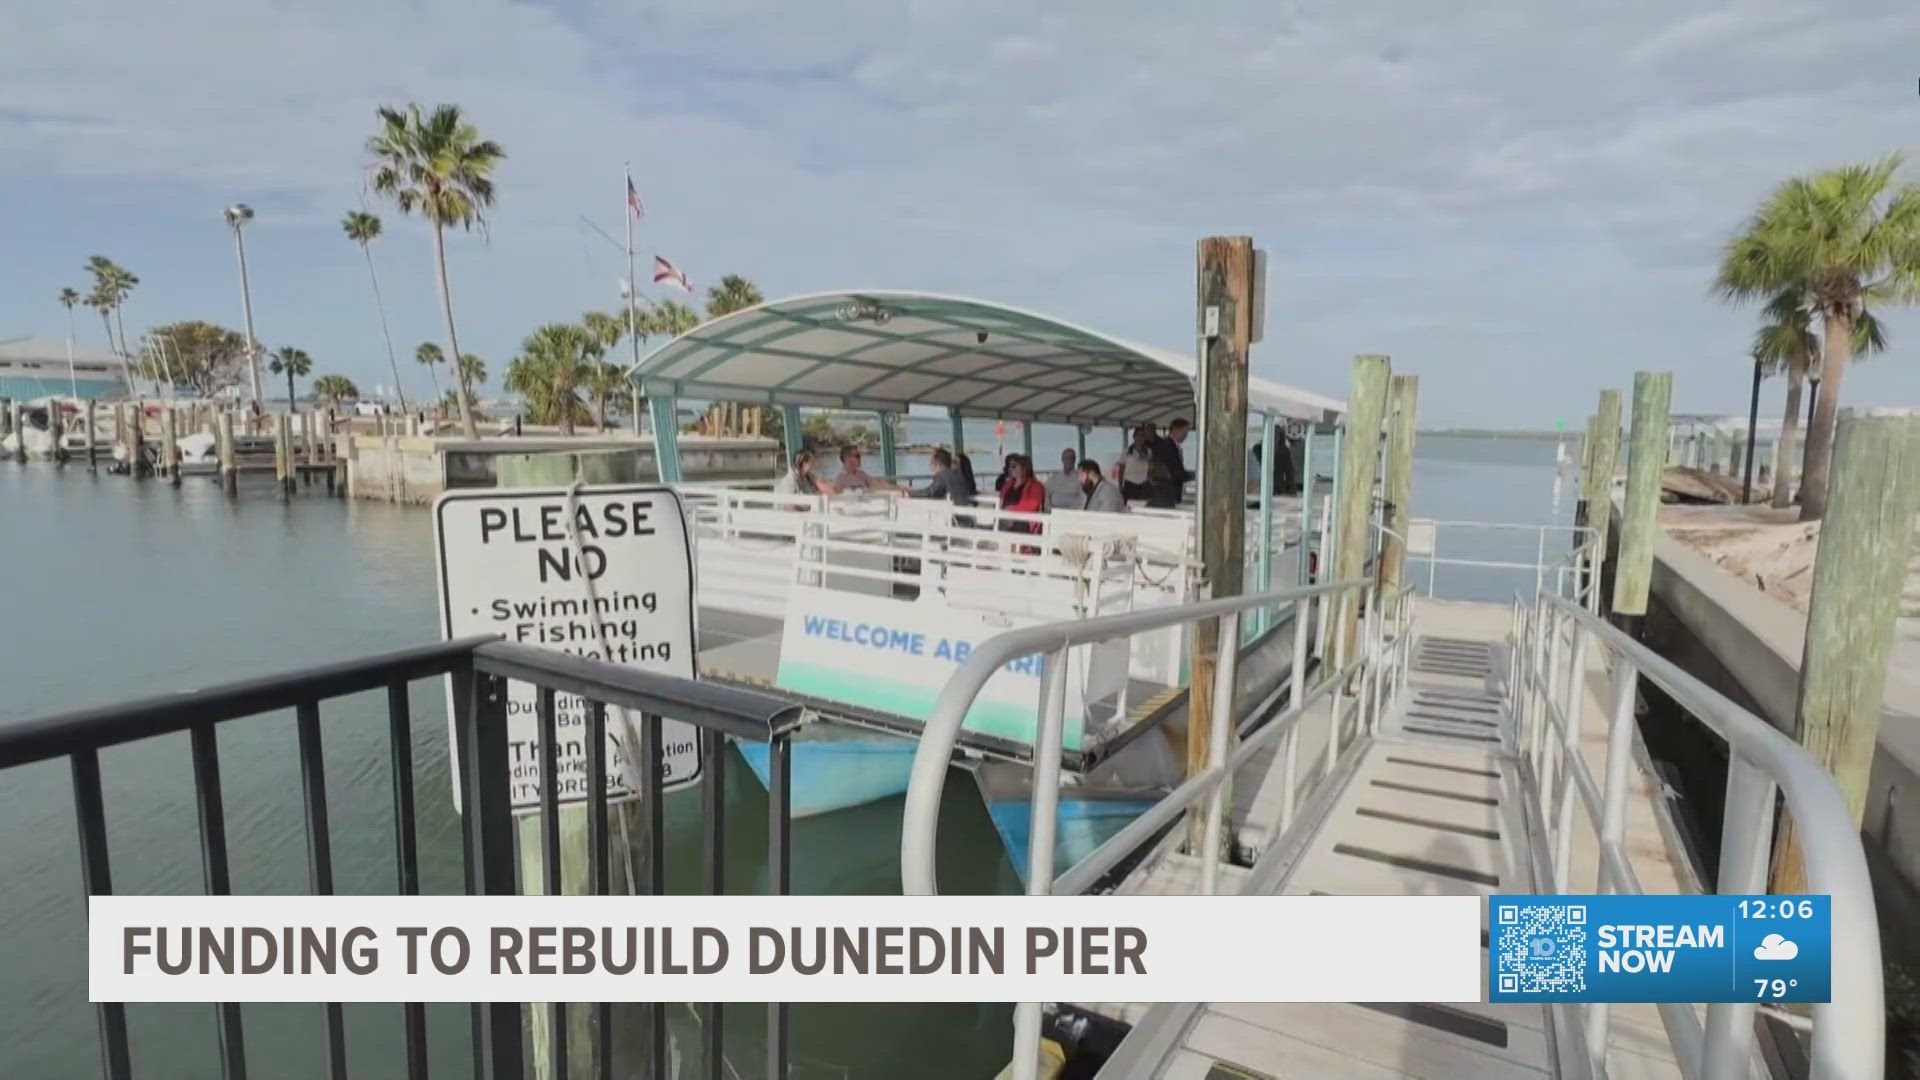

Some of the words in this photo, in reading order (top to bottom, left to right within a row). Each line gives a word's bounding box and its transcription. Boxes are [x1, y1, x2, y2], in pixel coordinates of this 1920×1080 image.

[480, 501, 656, 544] PLEASE
[538, 545, 607, 583] NO
[491, 591, 657, 621] Swimming
[516, 619, 637, 643] Fishing
[803, 614, 925, 655] WELCOME
[932, 637, 1043, 678] ABR
[508, 695, 587, 715] Dudin
[512, 783, 542, 799] ITY
